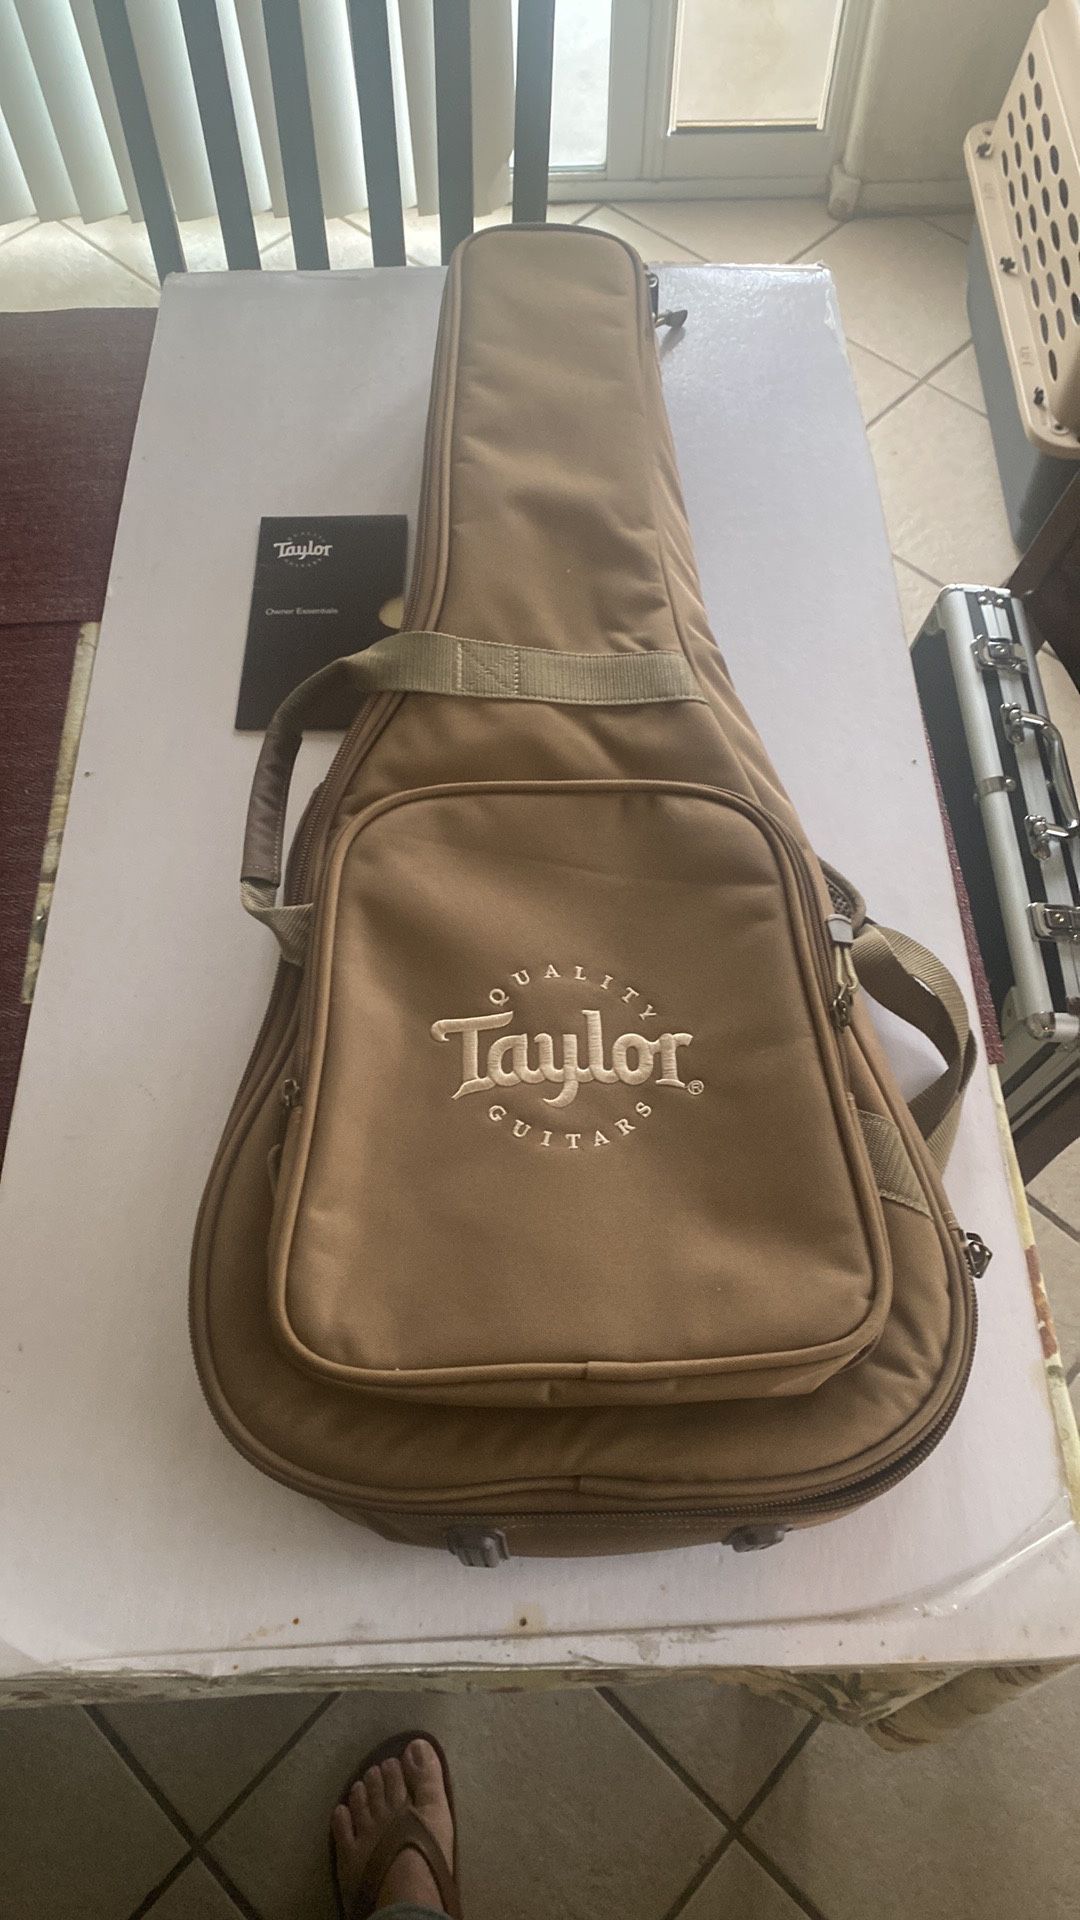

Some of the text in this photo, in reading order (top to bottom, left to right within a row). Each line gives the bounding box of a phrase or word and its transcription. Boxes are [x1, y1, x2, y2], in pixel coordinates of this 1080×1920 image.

[273, 540, 333, 560] Taylor
[265, 608, 294, 616] Owner
[489, 964, 657, 1020] QUALITY
[489, 1101, 652, 1149] GUITARS
